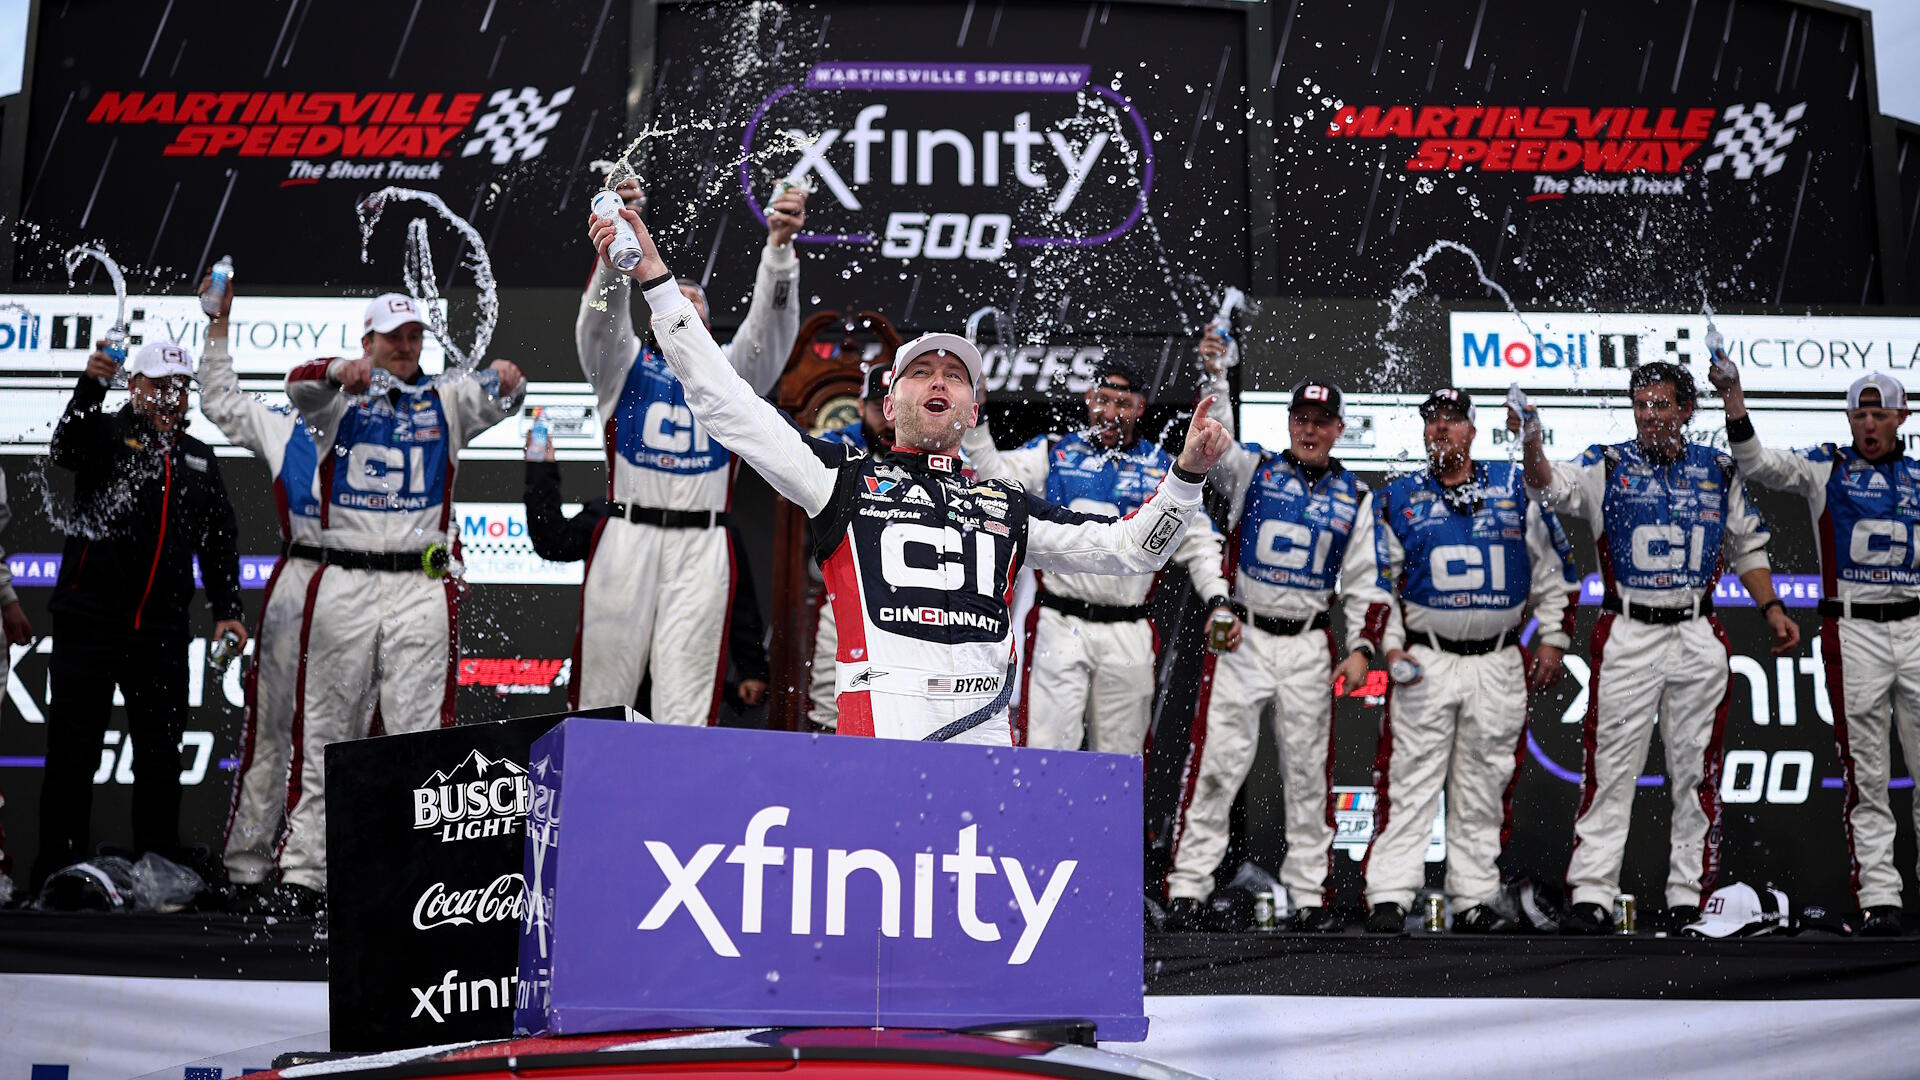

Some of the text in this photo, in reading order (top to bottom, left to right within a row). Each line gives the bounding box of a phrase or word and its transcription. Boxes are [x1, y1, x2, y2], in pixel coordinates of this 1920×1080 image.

[815, 69, 1083, 86] MARTINSVILLE SPEEDWAY
[87, 92, 484, 125] MARTINSVILLE
[1326, 105, 1717, 140] MARTINSVILLE
[162, 124, 472, 157] SPEEDWAY
[1405, 140, 1702, 174] SPEEDWAY
[289, 159, 444, 181] The Short Track
[788, 104, 1111, 213] xfinity
[1532, 176, 1686, 196] The Short Track
[881, 212, 1012, 260] 500
[166, 320, 328, 349] VITORY
[1462, 333, 1588, 369] Mobil
[1304, 386, 1329, 402] CI
[1492, 428, 1554, 445] BOH
[346, 442, 426, 493] CI
[929, 456, 951, 471] CI
[859, 508, 922, 521] GOODYEAR
[902, 497, 936, 508] AXALTA
[464, 515, 529, 537] Mob
[881, 522, 996, 598] CI
[1256, 518, 1334, 575] CI
[1630, 524, 1706, 572] CI
[1430, 544, 1506, 592] CI
[879, 606, 1002, 634] CINCINNATI
[953, 677, 1000, 693] BYRON
[1720, 750, 1815, 804] 00
[412, 776, 530, 830] BUSCH
[441, 816, 516, 843] LIGHT
[636, 805, 1079, 966] xfinity
[410, 966, 519, 1024] xfini
